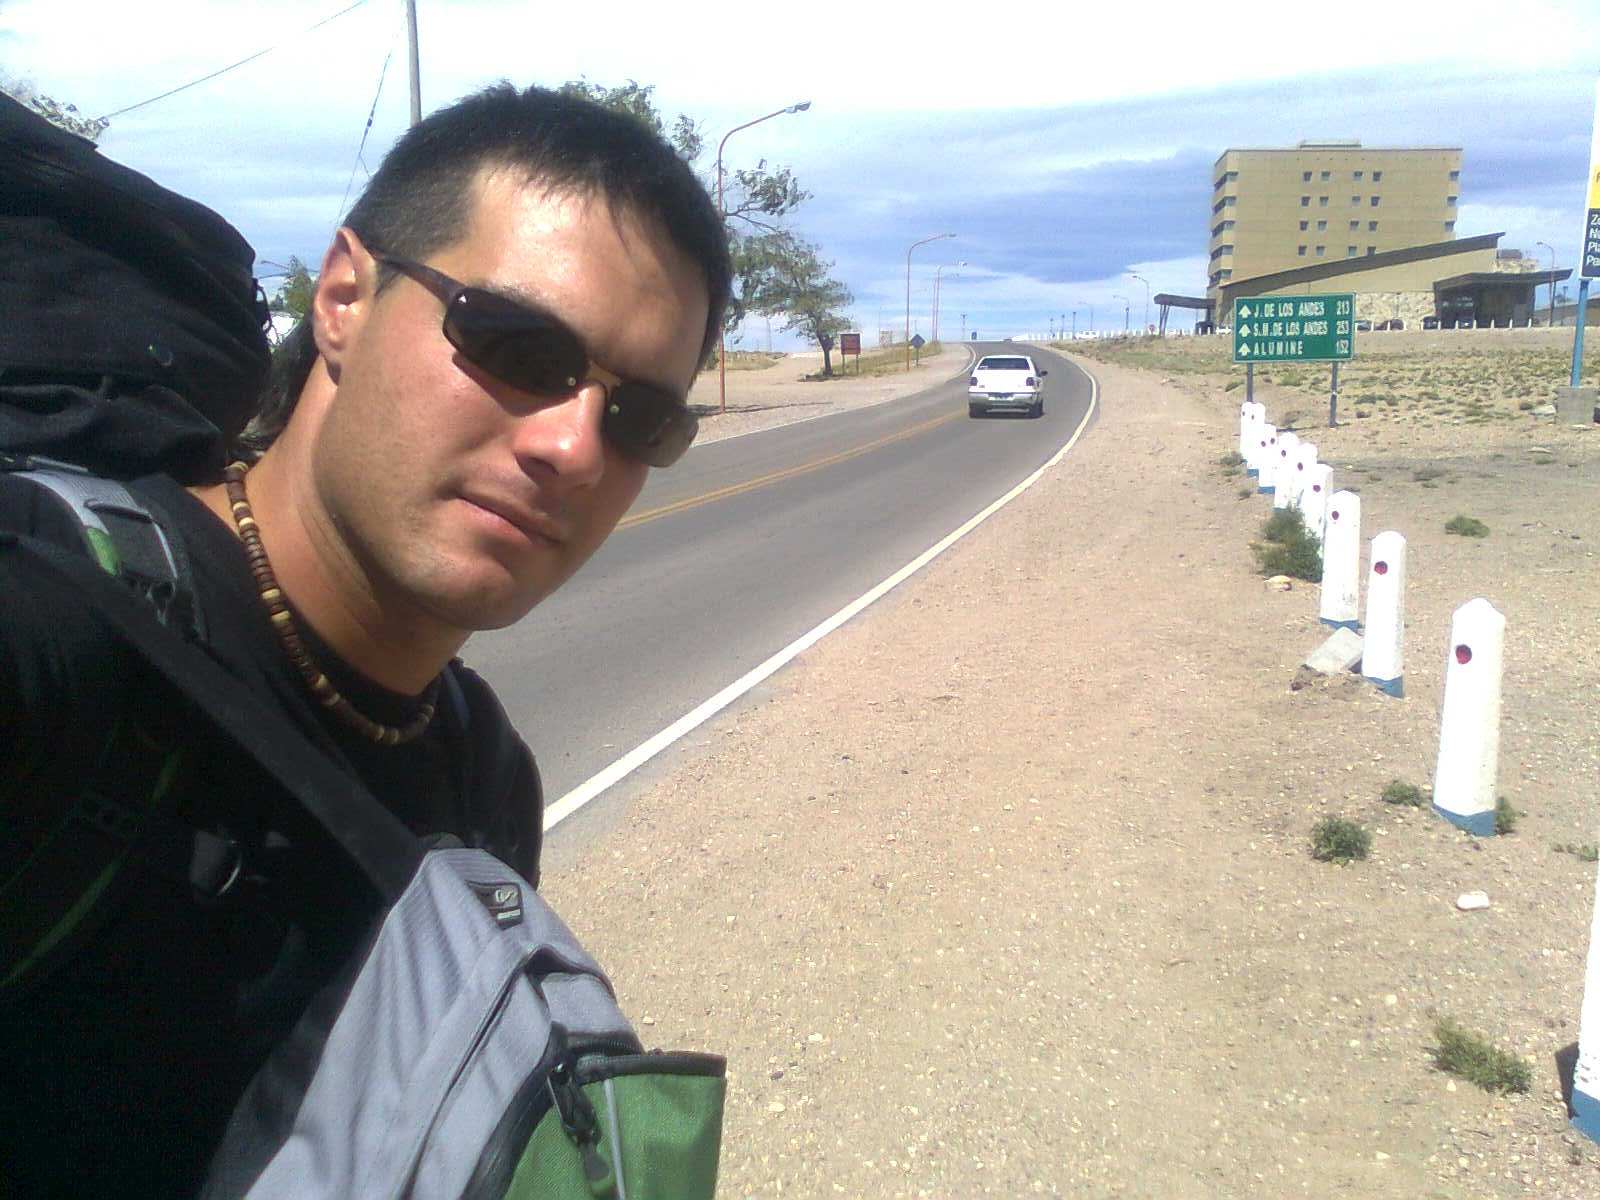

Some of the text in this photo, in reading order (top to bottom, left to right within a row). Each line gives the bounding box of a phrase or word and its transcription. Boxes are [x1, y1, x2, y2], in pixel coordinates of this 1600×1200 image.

[1278, 302, 1294, 317] LOS
[1298, 301, 1325, 317] ANDES
[1285, 321, 1300, 336] LOS
[1303, 320, 1328, 336] ANDES
[1253, 340, 1303, 355] ALUMINE
